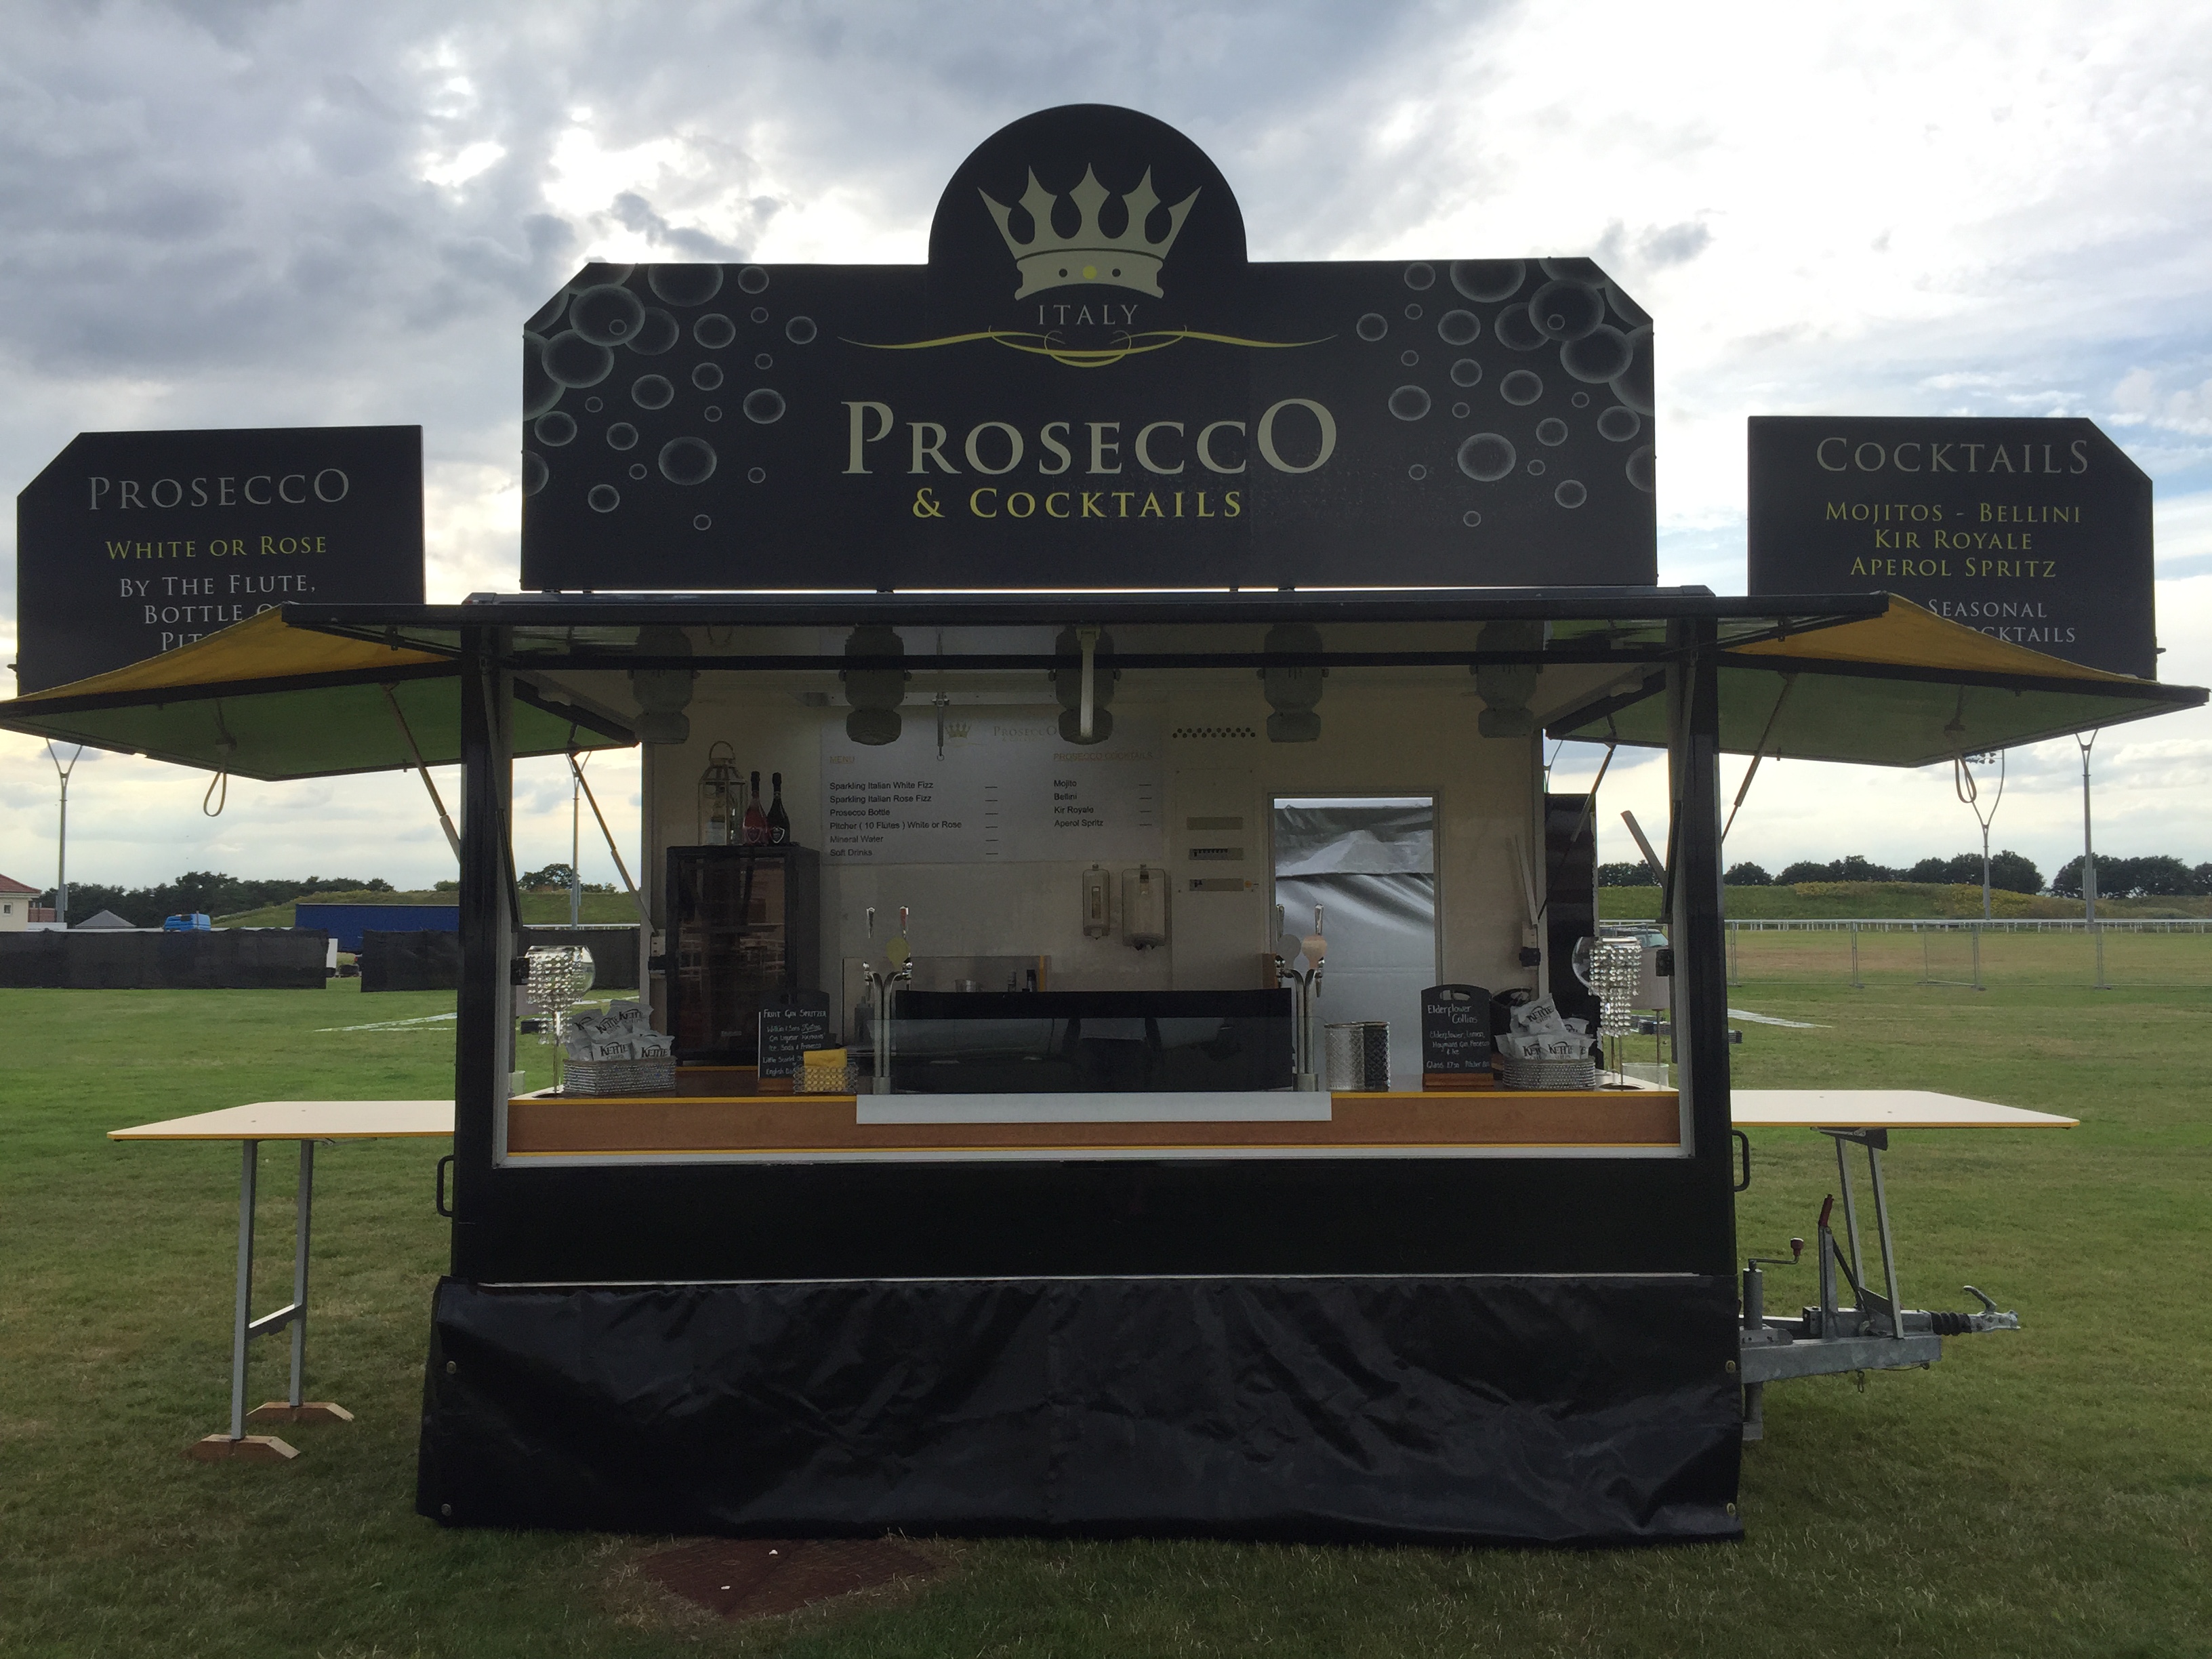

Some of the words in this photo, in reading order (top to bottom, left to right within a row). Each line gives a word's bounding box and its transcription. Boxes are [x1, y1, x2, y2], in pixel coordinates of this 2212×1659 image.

[1038, 304, 1139, 325] ITALY
[841, 398, 1337, 475] PROSECCO
[1816, 437, 2088, 474] COCKTAILS
[88, 468, 349, 510] PROSECCO
[912, 488, 945, 518] &
[970, 488, 1241, 518] COCKTAILS
[1826, 501, 1942, 525] MOJITOS
[1980, 504, 2080, 523] BELLINI
[106, 541, 196, 559] WHITE
[210, 539, 247, 556] OR
[261, 536, 326, 554] ROSE
[1875, 529, 1921, 549] KIR
[1934, 530, 2032, 550] ROYALE
[1851, 556, 1951, 576] APEROL
[1965, 558, 2056, 577] SPRITZ
[121, 578, 149, 598] BY
[162, 577, 214, 596] THE
[228, 574, 315, 594] FLUTE,
[144, 605, 243, 623] BOTTLE
[1928, 599, 2047, 618] SEASONAL
[1054, 752, 1103, 760] PROSECCO
[830, 782, 866, 791] Sparkling
[1054, 780, 1077, 789] Mojito
[830, 796, 866, 804] Sparkling
[1054, 806, 1065, 814] Kir
[1067, 806, 1094, 815] Royale
[1054, 819, 1079, 828] Aperol
[1082, 819, 1104, 827] Spritz
[764, 1008, 781, 1018] FRUIT
[1427, 1003, 1472, 1017] Elderflower
[1452, 1013, 1478, 1024] Collins
[600, 1042, 629, 1057] KETTLE
[641, 1044, 668, 1058] KETTLE
